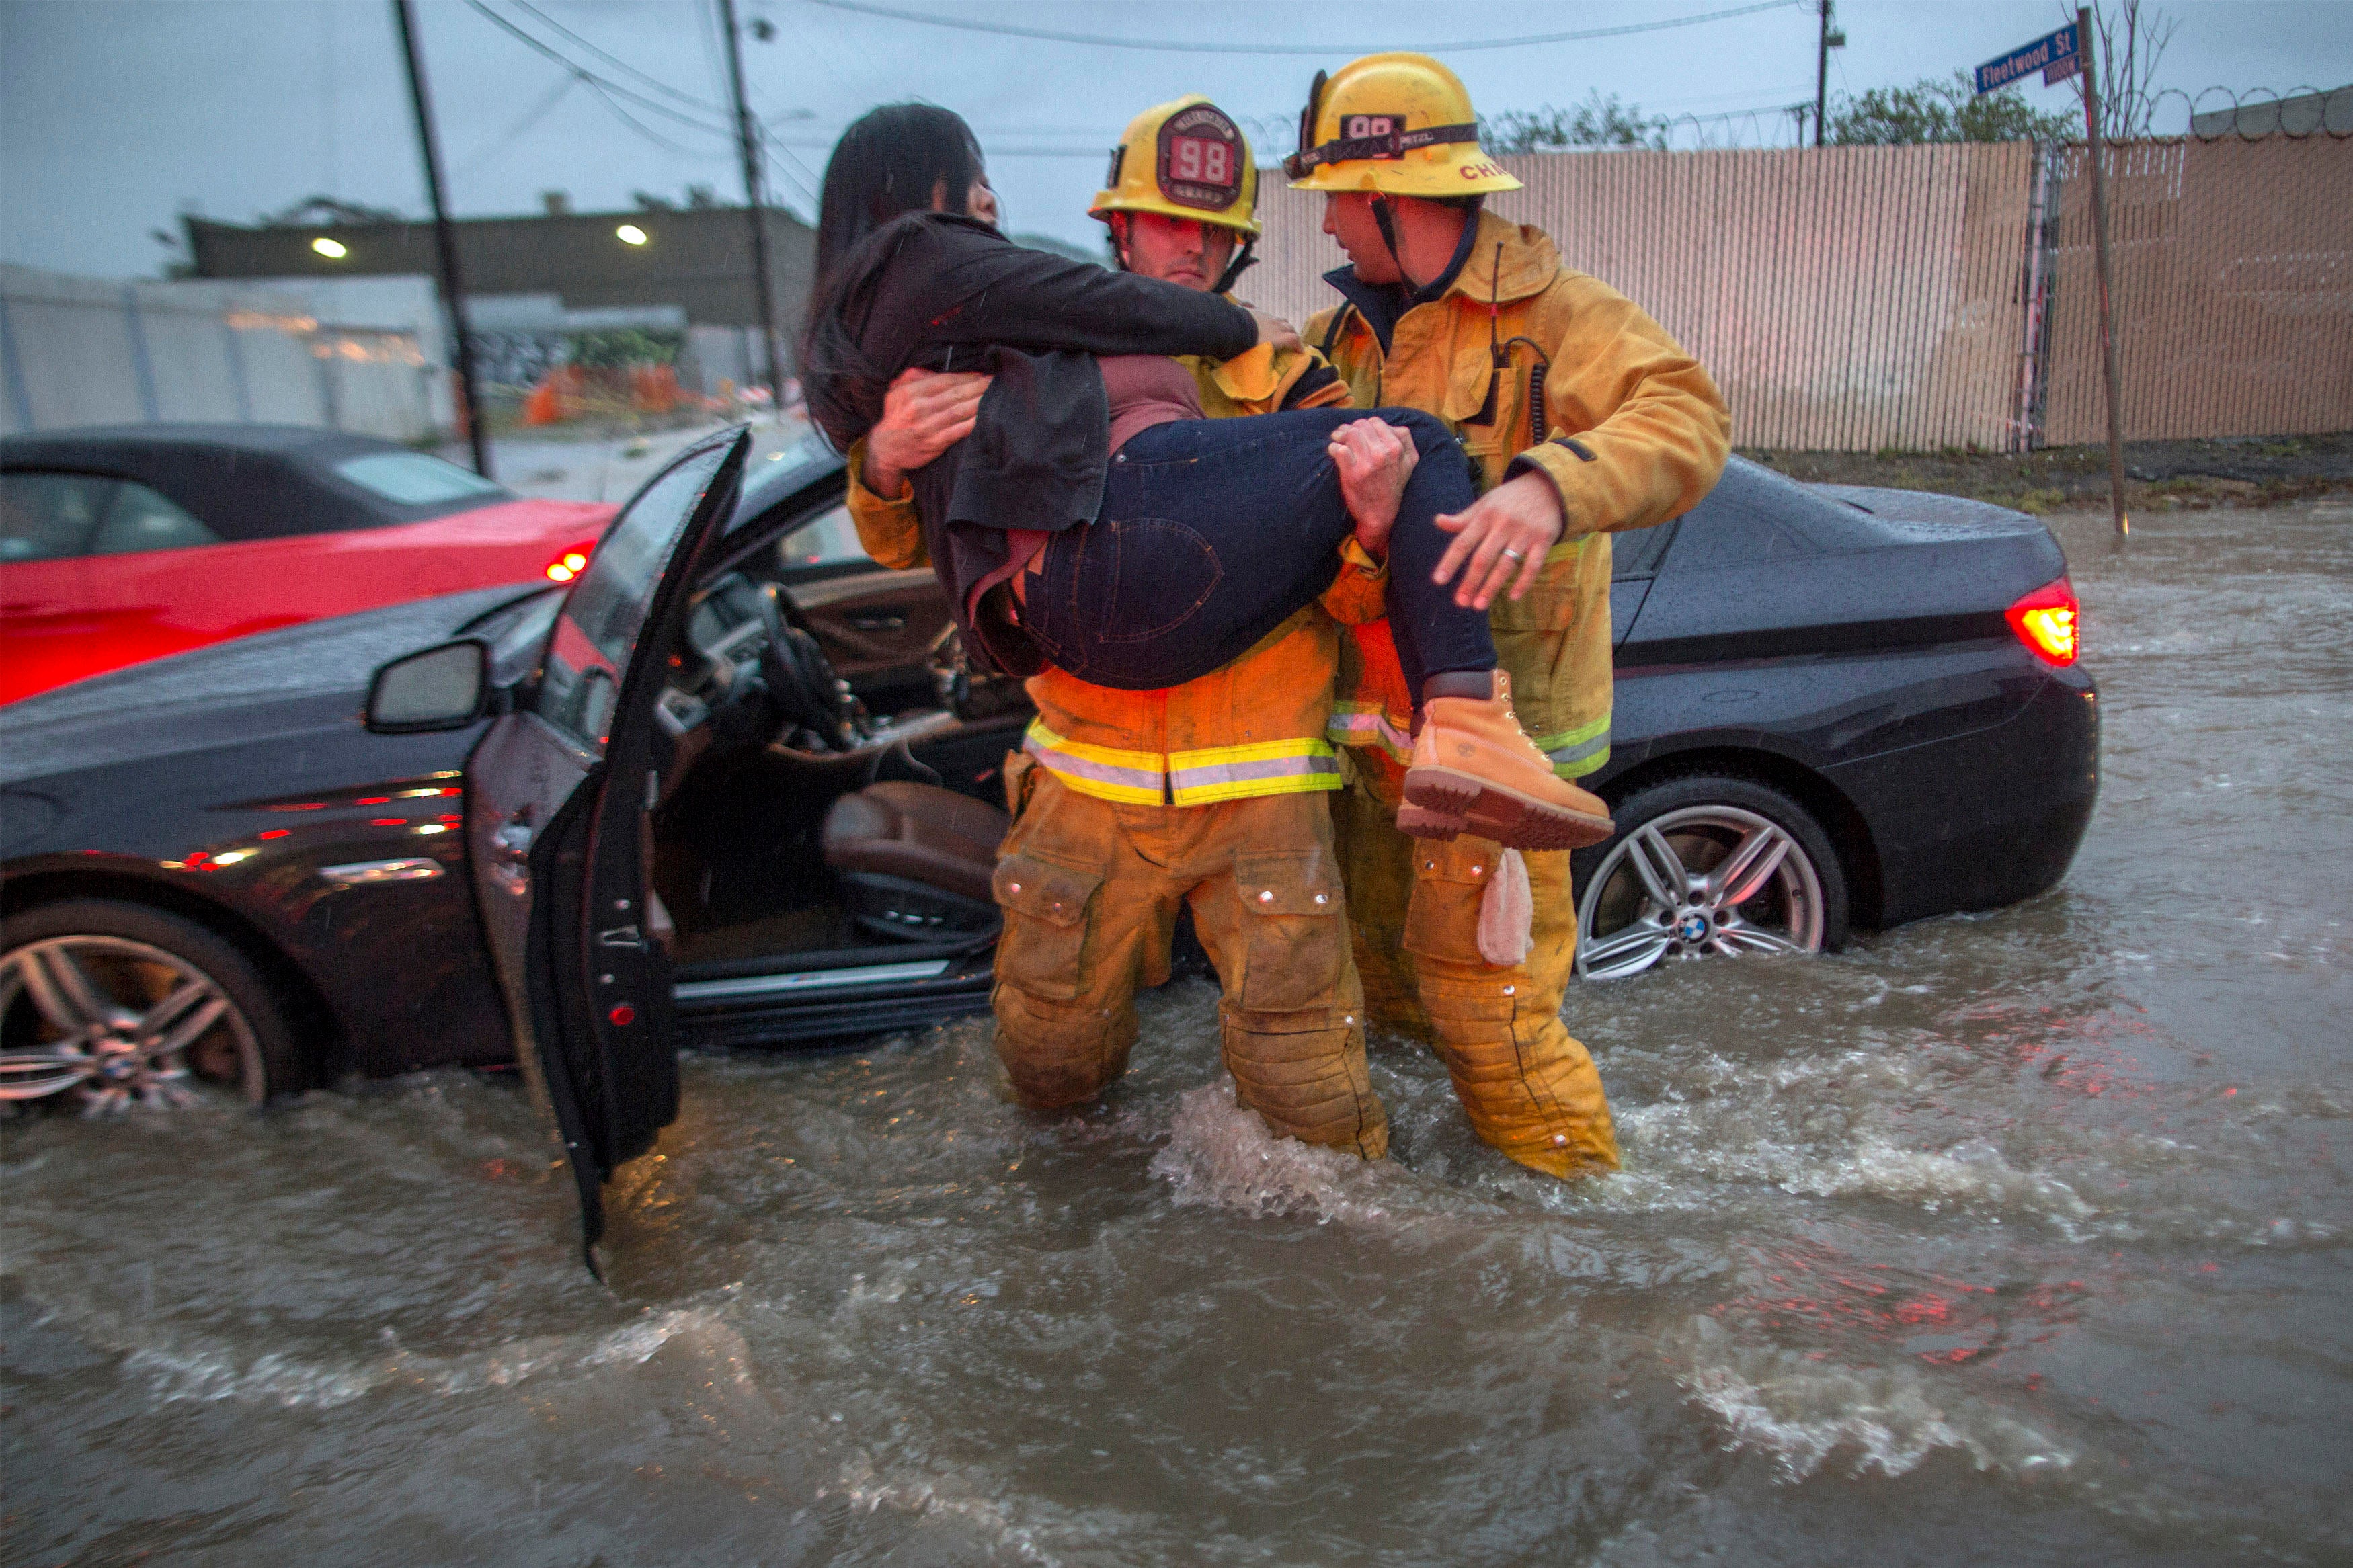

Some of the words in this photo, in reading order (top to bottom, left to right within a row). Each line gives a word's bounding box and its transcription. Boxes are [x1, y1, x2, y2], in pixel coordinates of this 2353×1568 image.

[1983, 42, 2049, 88] Fleetwood
[2054, 31, 2071, 55] St
[1179, 139, 1226, 182] 98
